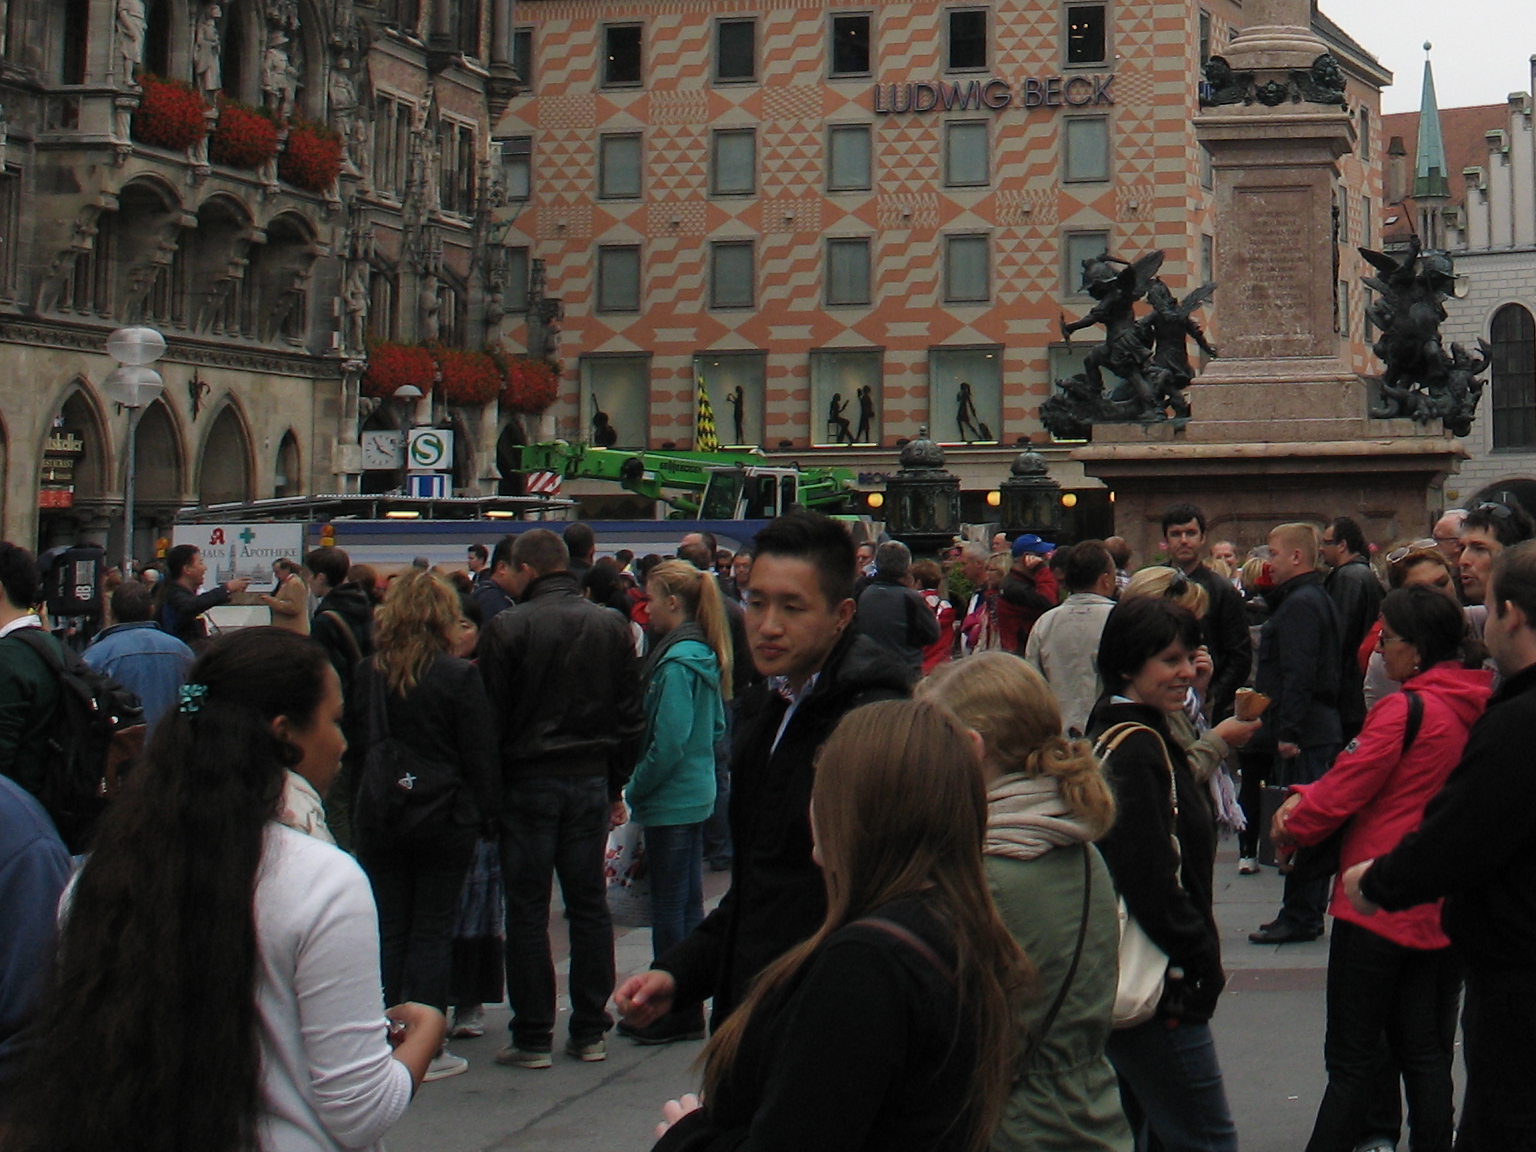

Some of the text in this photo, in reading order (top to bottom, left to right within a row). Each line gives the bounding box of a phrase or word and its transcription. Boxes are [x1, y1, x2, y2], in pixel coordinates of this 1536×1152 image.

[873, 73, 1116, 114] LUDWIG BECK
[46, 433, 83, 451] tskeller
[415, 434, 439, 464] S
